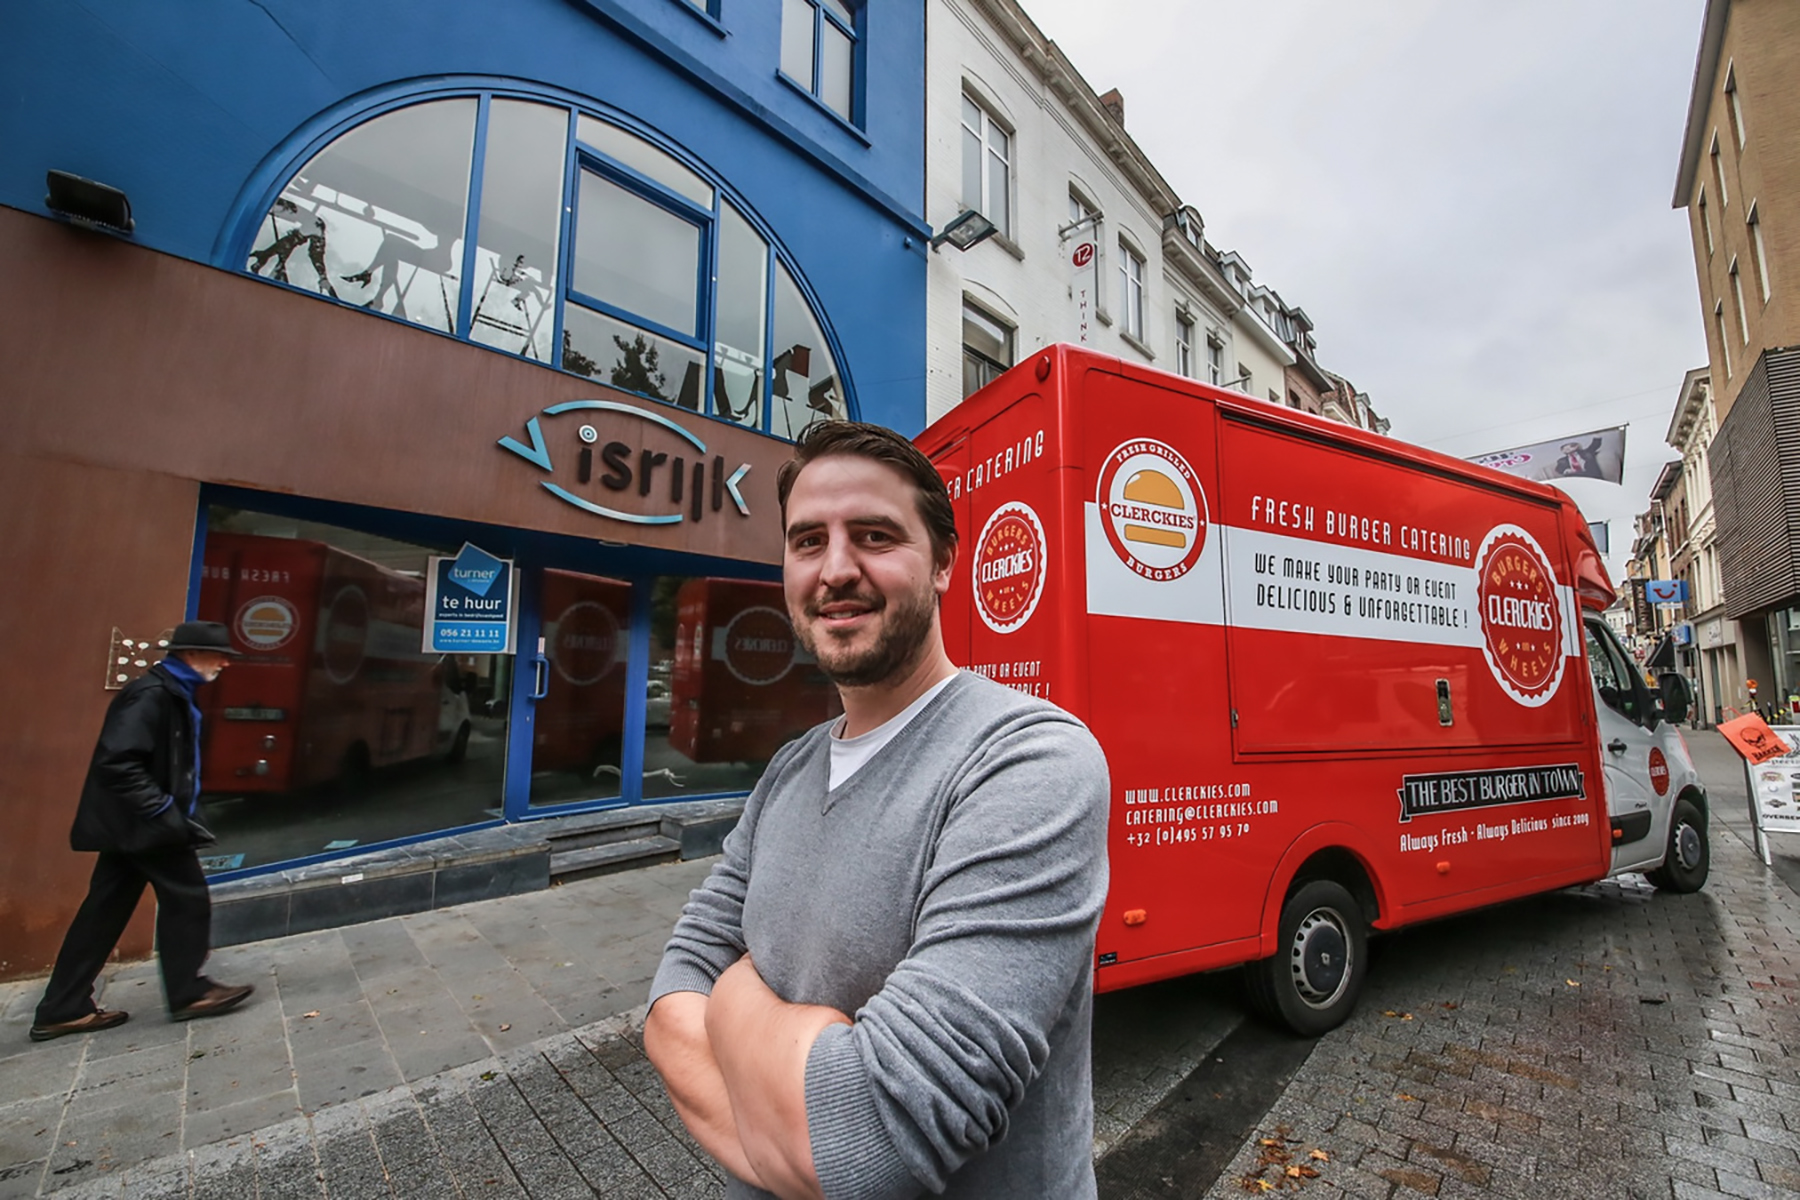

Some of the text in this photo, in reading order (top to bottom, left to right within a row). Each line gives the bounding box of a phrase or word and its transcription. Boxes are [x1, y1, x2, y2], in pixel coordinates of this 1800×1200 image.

[1080, 289, 1088, 342] THINK
[966, 429, 1044, 493] CATERING
[1116, 443, 1192, 479] FRESH GRILLED
[1110, 503, 1195, 530] CLERCKIES
[1251, 495, 1471, 561] FRESH BURGER CATERING
[454, 568, 495, 579] turner
[1126, 556, 1188, 580] BURGERS
[1255, 553, 1456, 600] WE MAKE YOUR PARTY OR EVENT
[1491, 555, 1544, 593] BURGERS
[442, 595, 502, 610] te huur
[1257, 583, 1336, 615] DELICIOUS
[1344, 594, 1352, 616] &
[1359, 596, 1459, 628] UNFORGETTABLE
[440, 629, 500, 638] 056 21 11 11
[999, 662, 1010, 678] OR
[1498, 638, 1552, 678] WHEELS
[1406, 780, 1439, 807] THE
[1440, 777, 1477, 804] BEST
[1480, 773, 1529, 801] BURGER
[1543, 768, 1579, 793] TOWN
[1127, 823, 1250, 848] +32 (0)495 57 95 70
[1400, 833, 1439, 853] Always
[1441, 826, 1469, 847] Fresh
[1476, 823, 1510, 841] Always
[1511, 817, 1548, 835] Delicious
[1573, 813, 1590, 827] 2009
